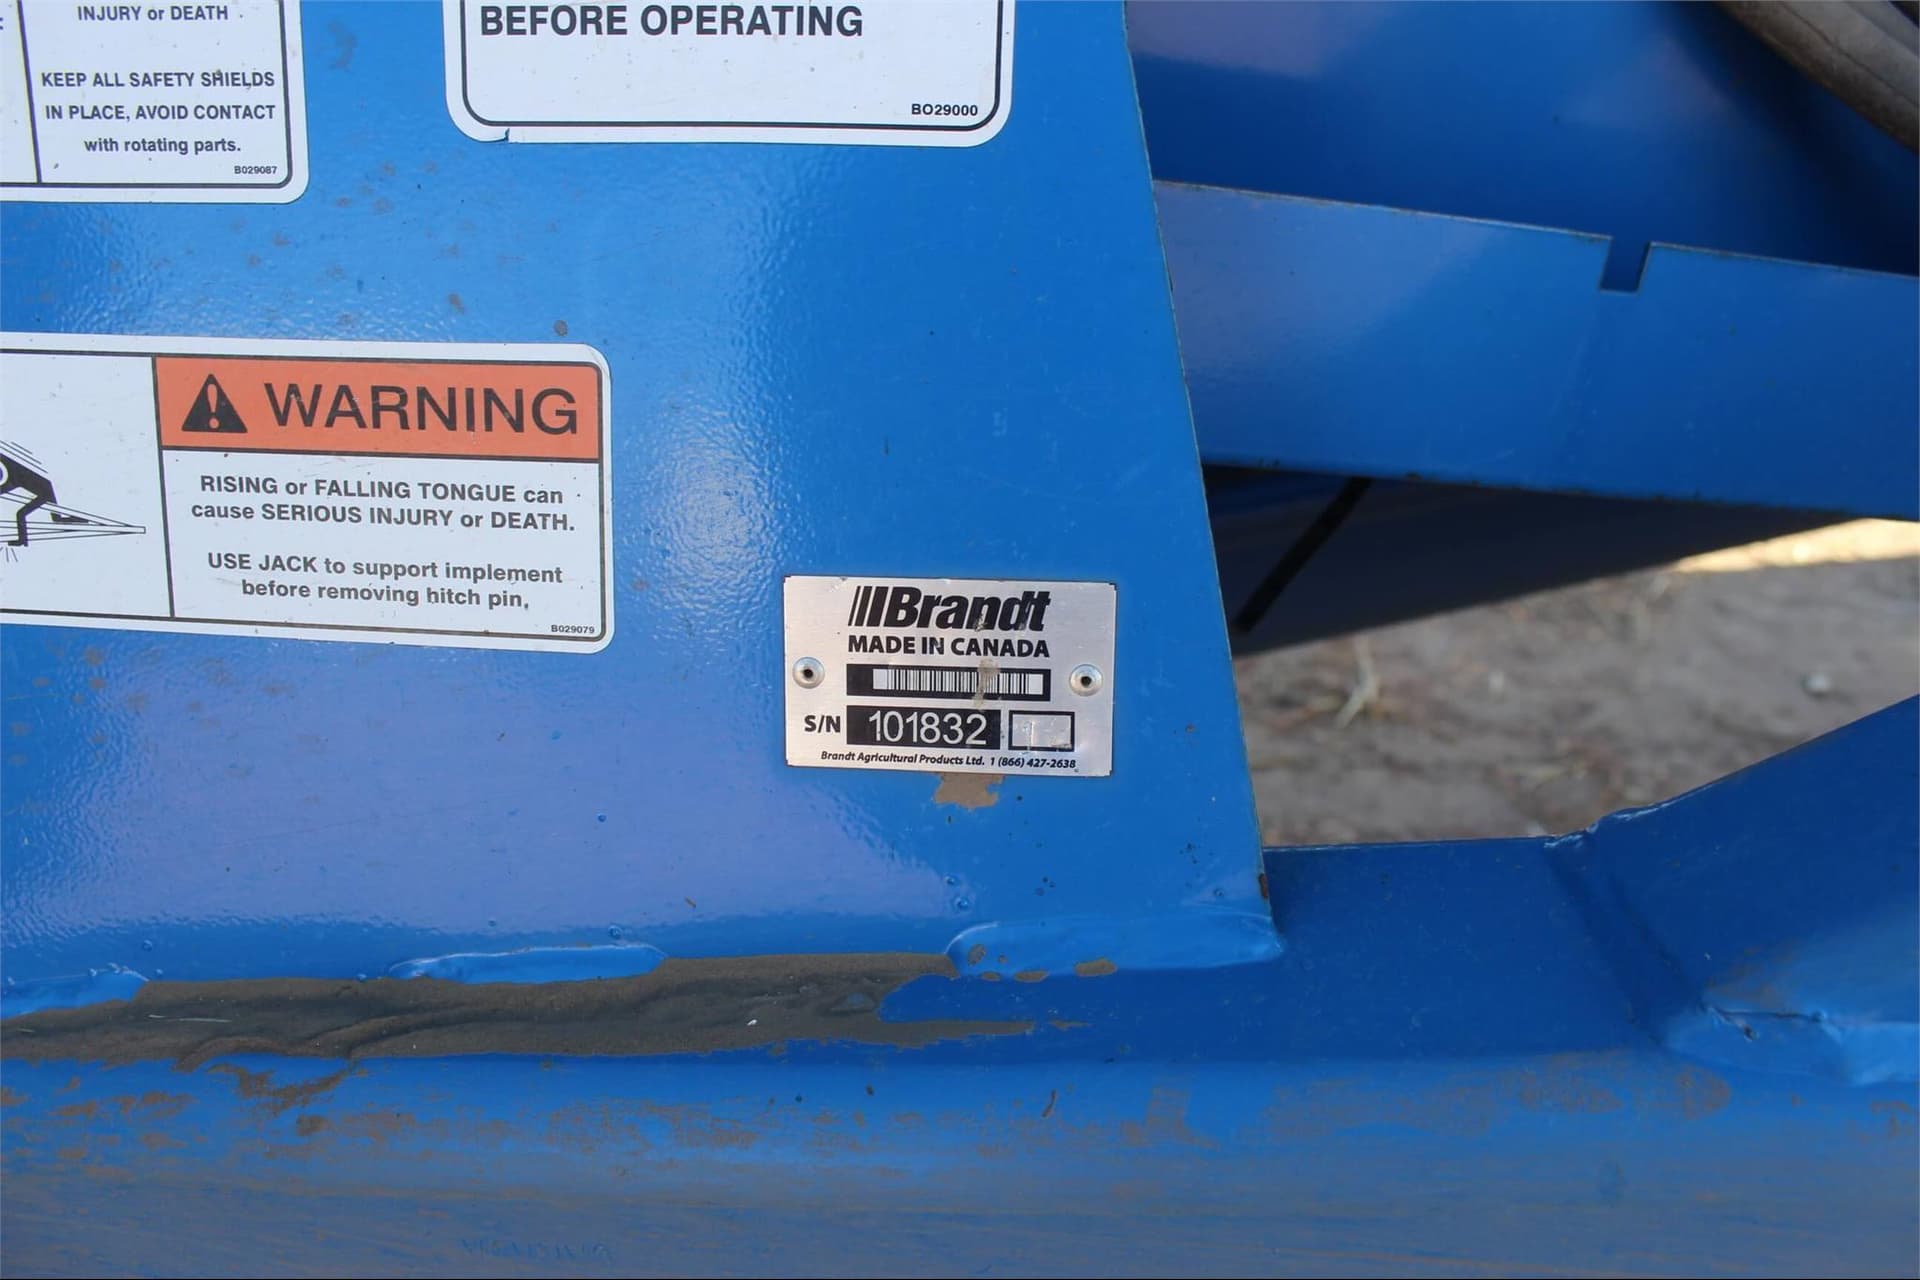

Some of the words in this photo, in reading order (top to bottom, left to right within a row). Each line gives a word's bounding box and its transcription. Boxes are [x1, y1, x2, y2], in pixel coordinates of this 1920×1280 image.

[78, 6, 141, 21] INJURY
[148, 9, 164, 21] or
[170, 5, 228, 21] DEATH
[480, 5, 627, 36] BEFORE
[640, 4, 863, 37] OPERATING
[41, 72, 87, 88] KEEP
[92, 72, 125, 88] ALL
[129, 72, 195, 88] SAFETY
[201, 71, 275, 88] SHIELDS
[46, 104, 63, 120] IN
[69, 105, 131, 122] PLACE,
[135, 105, 189, 120] AVOID
[193, 104, 276, 120] CONTACT
[84, 138, 119, 152] with
[124, 138, 189, 155] rotating
[194, 138, 241, 155] parts.
[263, 381, 579, 434] WARNING
[200, 474, 278, 495] RISING
[285, 480, 309, 496] or
[314, 478, 411, 500] FALLING
[417, 482, 516, 503] TONGUE
[522, 488, 564, 504] can
[191, 503, 255, 520] cause
[261, 502, 361, 524] SERIOUS
[369, 505, 453, 528] INJURY
[459, 513, 484, 529] or
[490, 509, 575, 531] DEATH.
[207, 553, 252, 571] USE
[258, 555, 318, 575] JACK
[324, 558, 346, 575] to
[352, 562, 439, 580] support
[444, 561, 563, 584] implement
[241, 580, 311, 599] before
[317, 584, 419, 607] removing
[426, 588, 481, 606] hitch
[885, 586, 1051, 632] Brandt
[847, 635, 915, 654] MADE
[921, 636, 944, 655] IN
[950, 637, 1050, 658] CANADA
[803, 715, 842, 733] S/N
[868, 709, 988, 746] 101832
[820, 750, 855, 762] Brandt
[857, 751, 917, 765] Agricultural
[919, 754, 963, 766] Products
[964, 756, 985, 766] Ltd.
[989, 757, 996, 767] 1
[997, 757, 1025, 769] (866)
[1026, 757, 1077, 770] 427-2638
